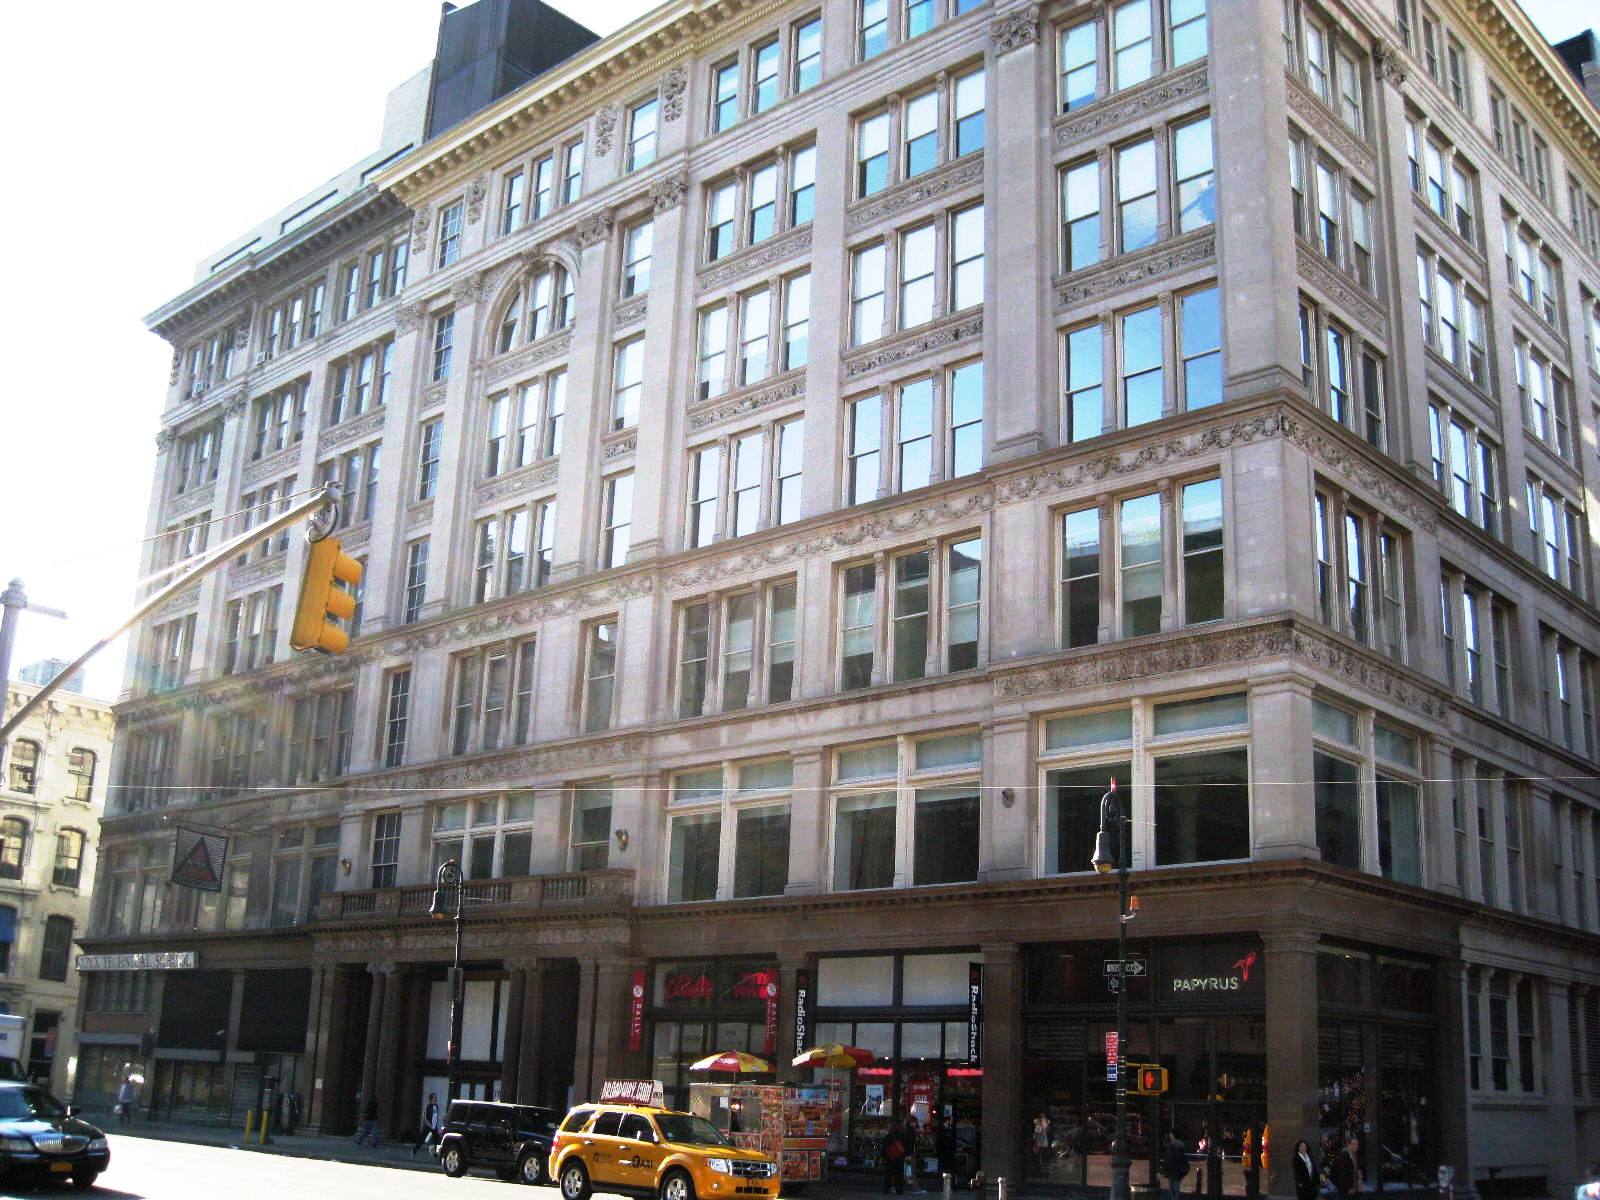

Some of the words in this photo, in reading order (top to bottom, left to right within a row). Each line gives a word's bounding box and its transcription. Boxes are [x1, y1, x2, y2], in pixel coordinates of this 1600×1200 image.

[1173, 976, 1239, 992] PAPYRUS
[634, 1003, 642, 1034] BALLY
[769, 1002, 777, 1035] BALLY
[796, 989, 806, 1057] RadioShac
[970, 985, 979, 1063] RadioShack
